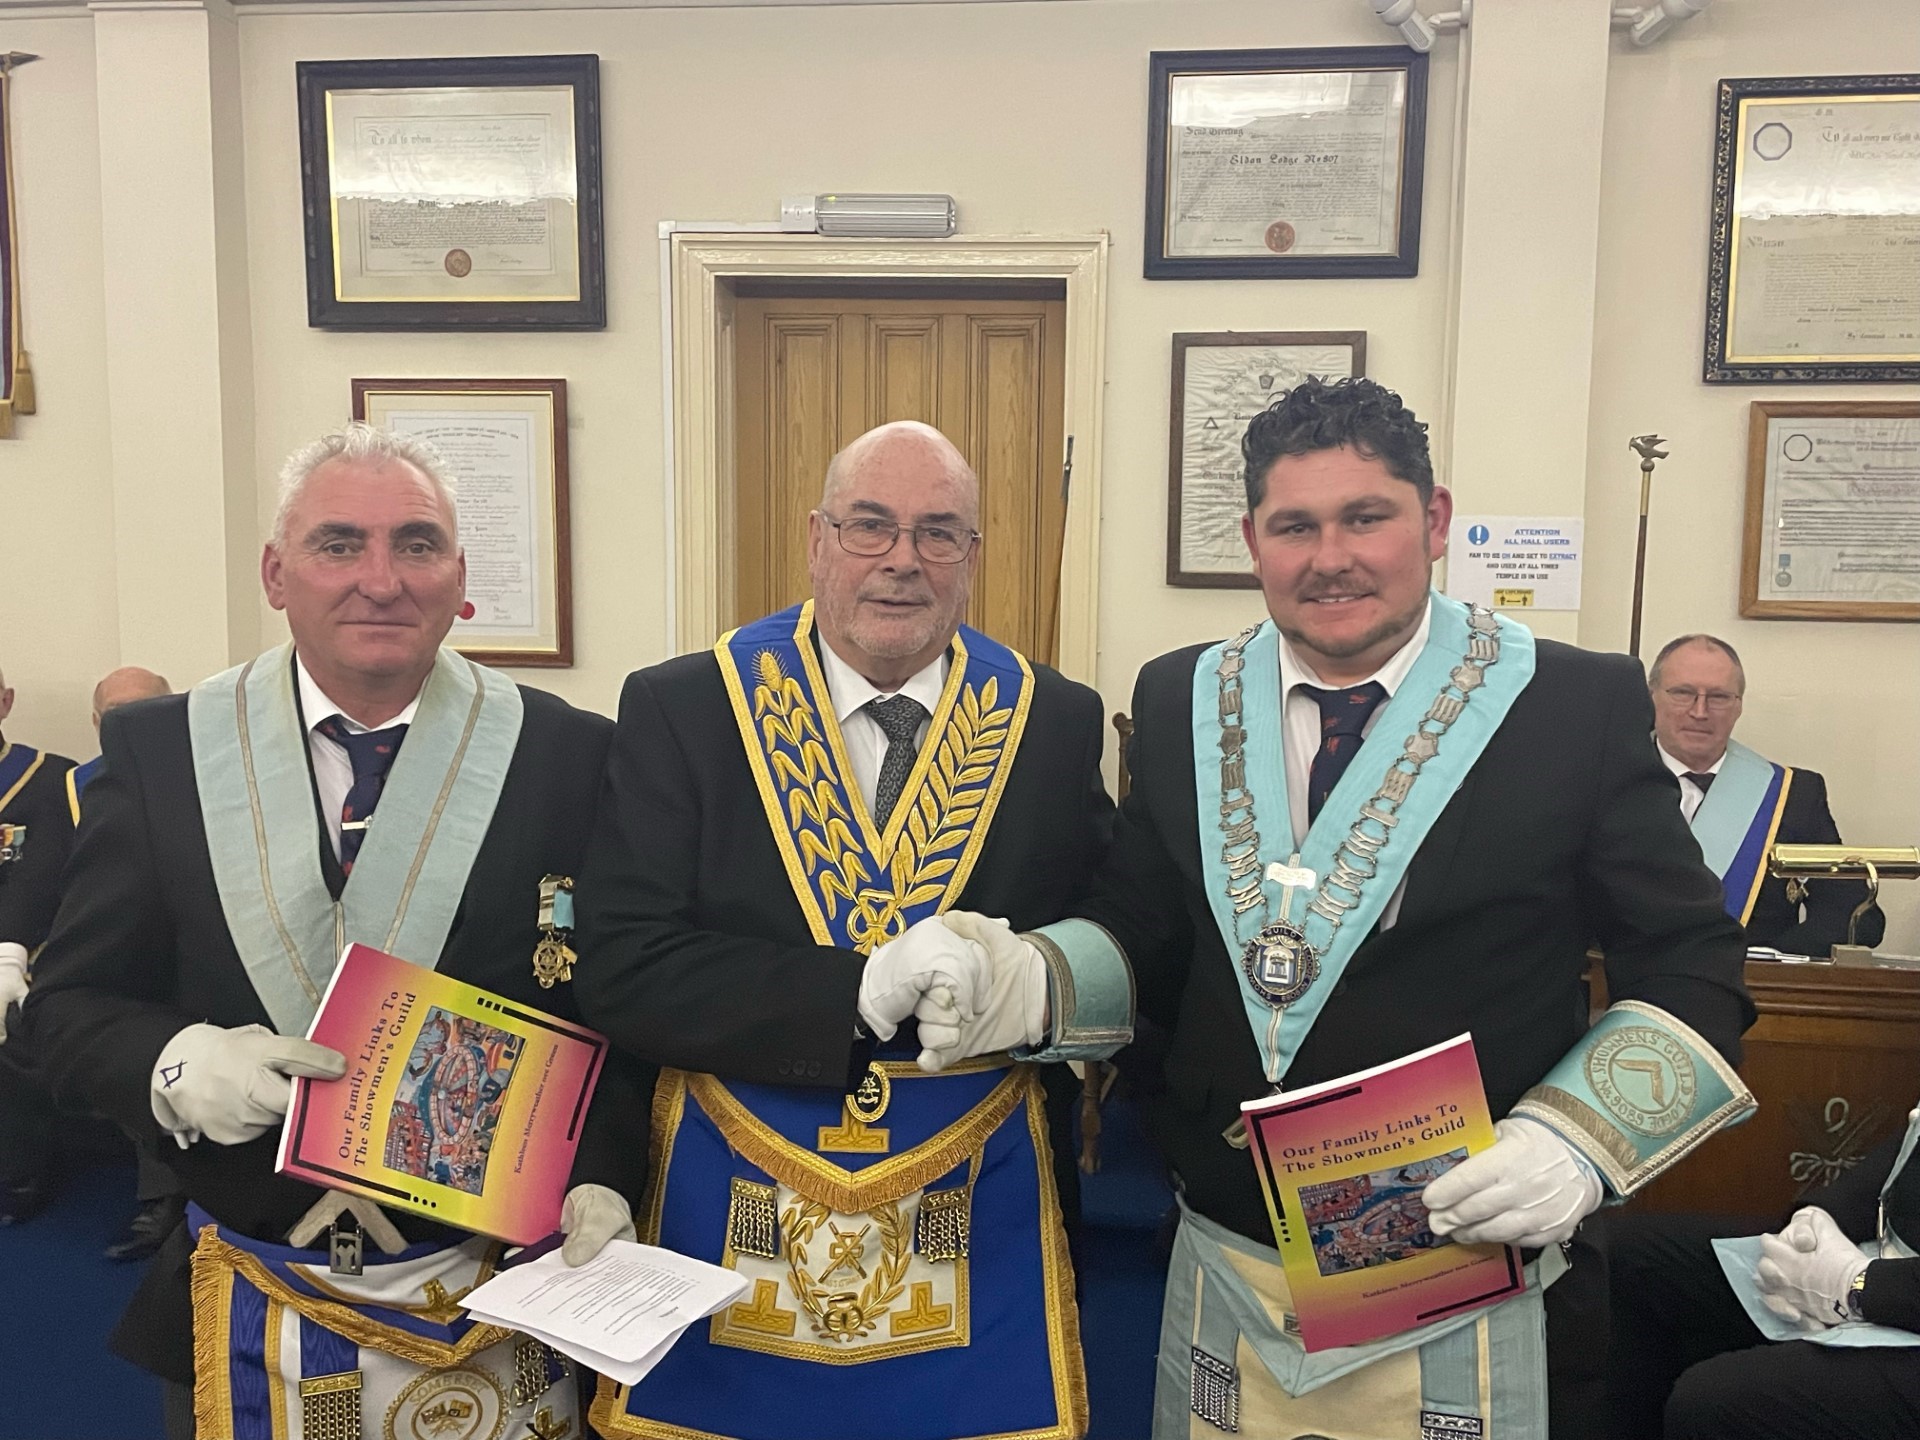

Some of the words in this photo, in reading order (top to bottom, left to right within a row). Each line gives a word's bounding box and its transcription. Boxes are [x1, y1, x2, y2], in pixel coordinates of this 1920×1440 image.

[1266, 926, 1297, 938] GUILD
[382, 991, 398, 1011] To
[389, 992, 416, 1037] Guild
[360, 1018, 388, 1062] Links
[1592, 1031, 1660, 1075] SHOWMENS
[1664, 1043, 1692, 1096] GUILD
[344, 1068, 368, 1122] Family
[360, 1042, 394, 1131] Showmen's
[1282, 1145, 1314, 1159] Our
[1322, 1129, 1379, 1150] Family
[1386, 1115, 1432, 1134] Links
[1436, 1104, 1458, 1118] To
[1610, 1095, 1645, 1126] 9089
[338, 1128, 353, 1158] Our
[354, 1138, 368, 1167] The
[1282, 1158, 1316, 1174] The
[1322, 1136, 1415, 1166] Showmen's
[1421, 1116, 1466, 1140] Guild
[410, 1373, 490, 1406] SOMERSET
